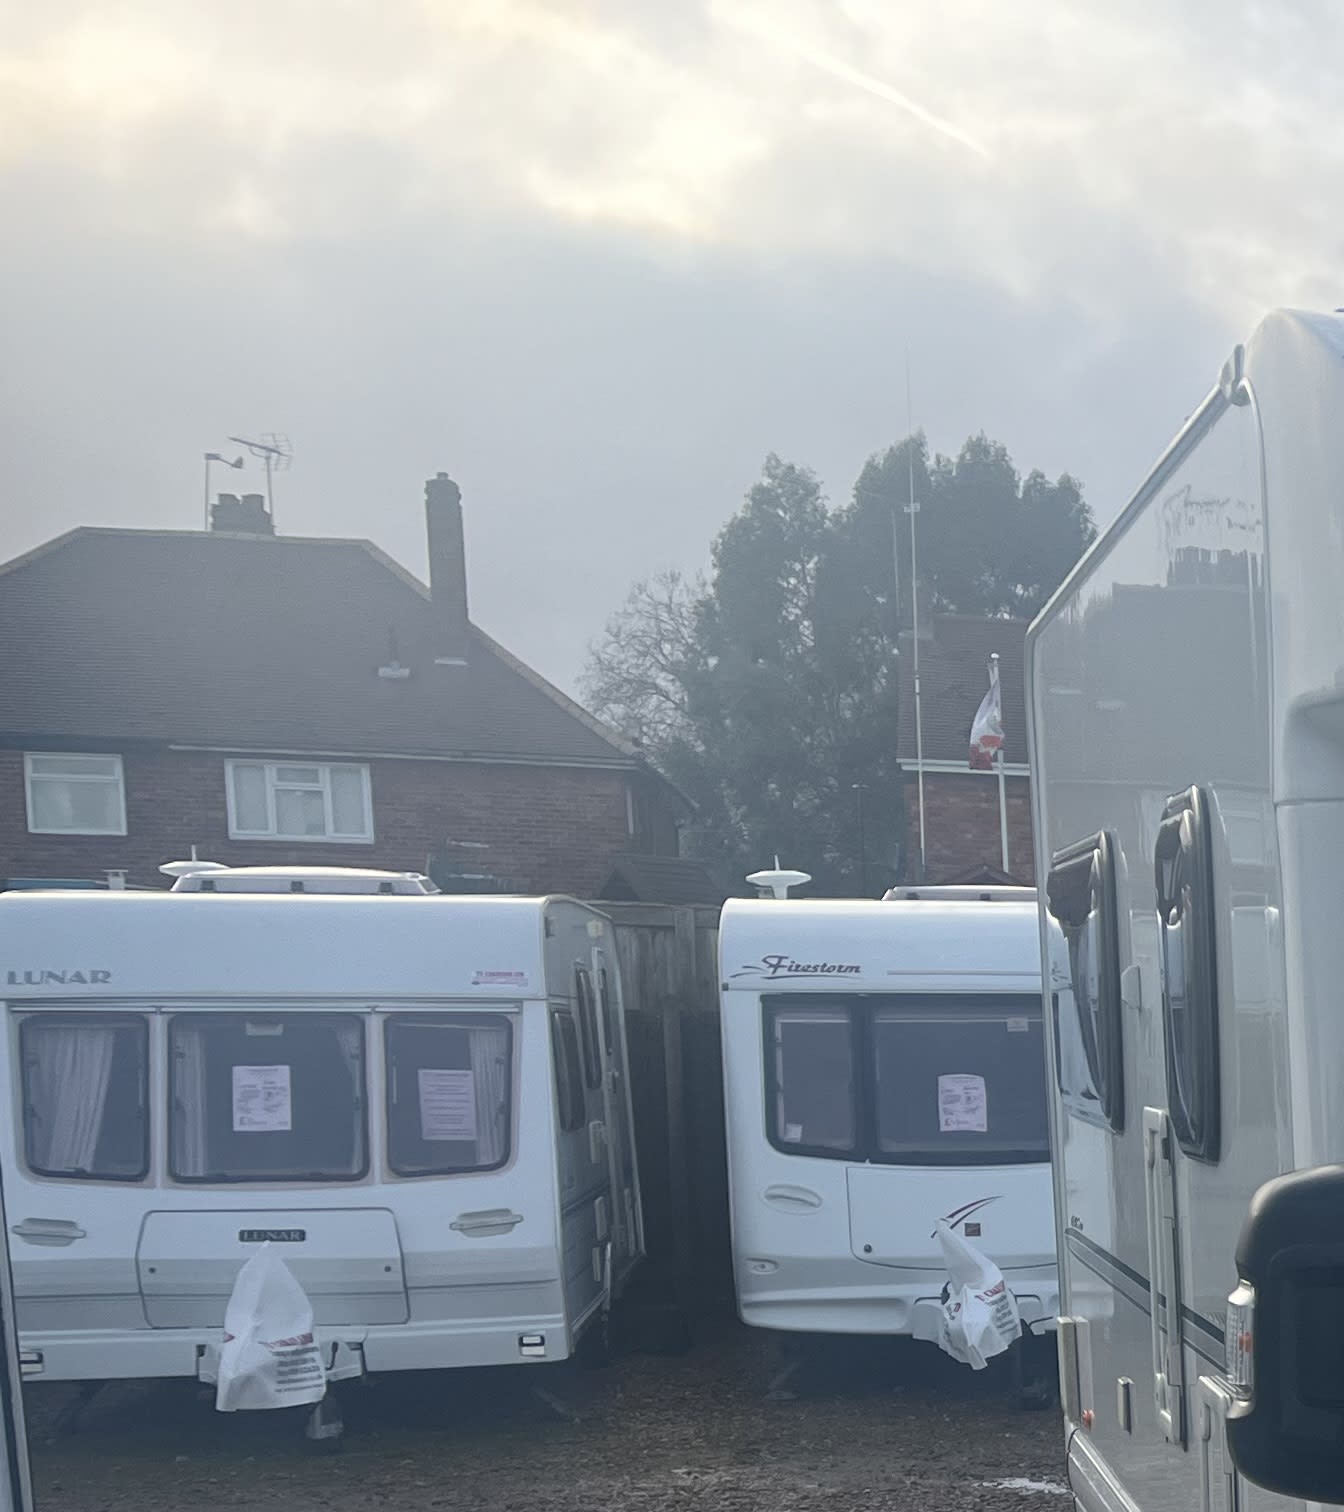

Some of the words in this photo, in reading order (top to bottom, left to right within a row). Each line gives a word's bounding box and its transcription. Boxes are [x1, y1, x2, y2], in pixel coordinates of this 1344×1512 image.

[761, 954, 862, 975] Firestorm
[6, 969, 113, 985] LUNAR
[243, 1231, 301, 1241] LUNAR
